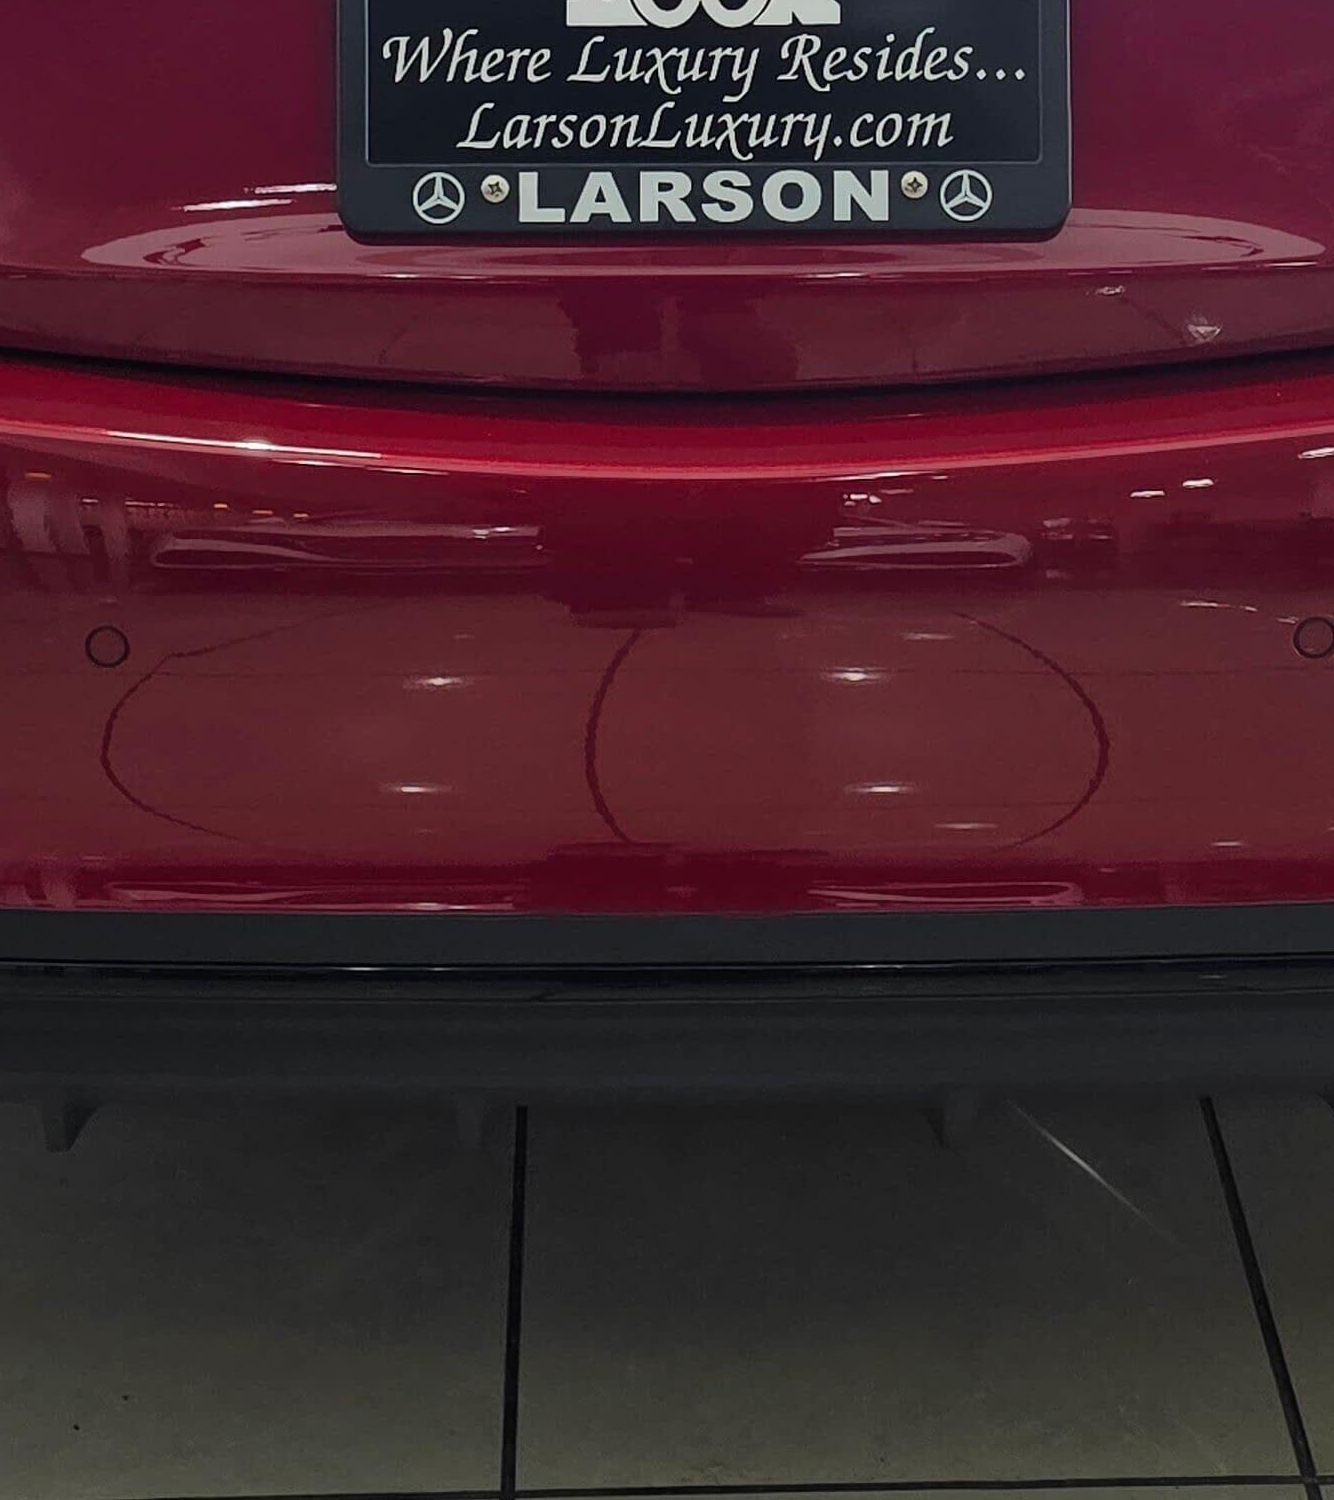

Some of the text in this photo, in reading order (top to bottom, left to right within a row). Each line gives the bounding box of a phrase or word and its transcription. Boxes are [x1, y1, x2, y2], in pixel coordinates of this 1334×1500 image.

[381, 27, 1027, 102] Where Luxury Resides...
[457, 102, 953, 161] LarsonLuxury.com
[518, 170, 890, 224] LARSON
